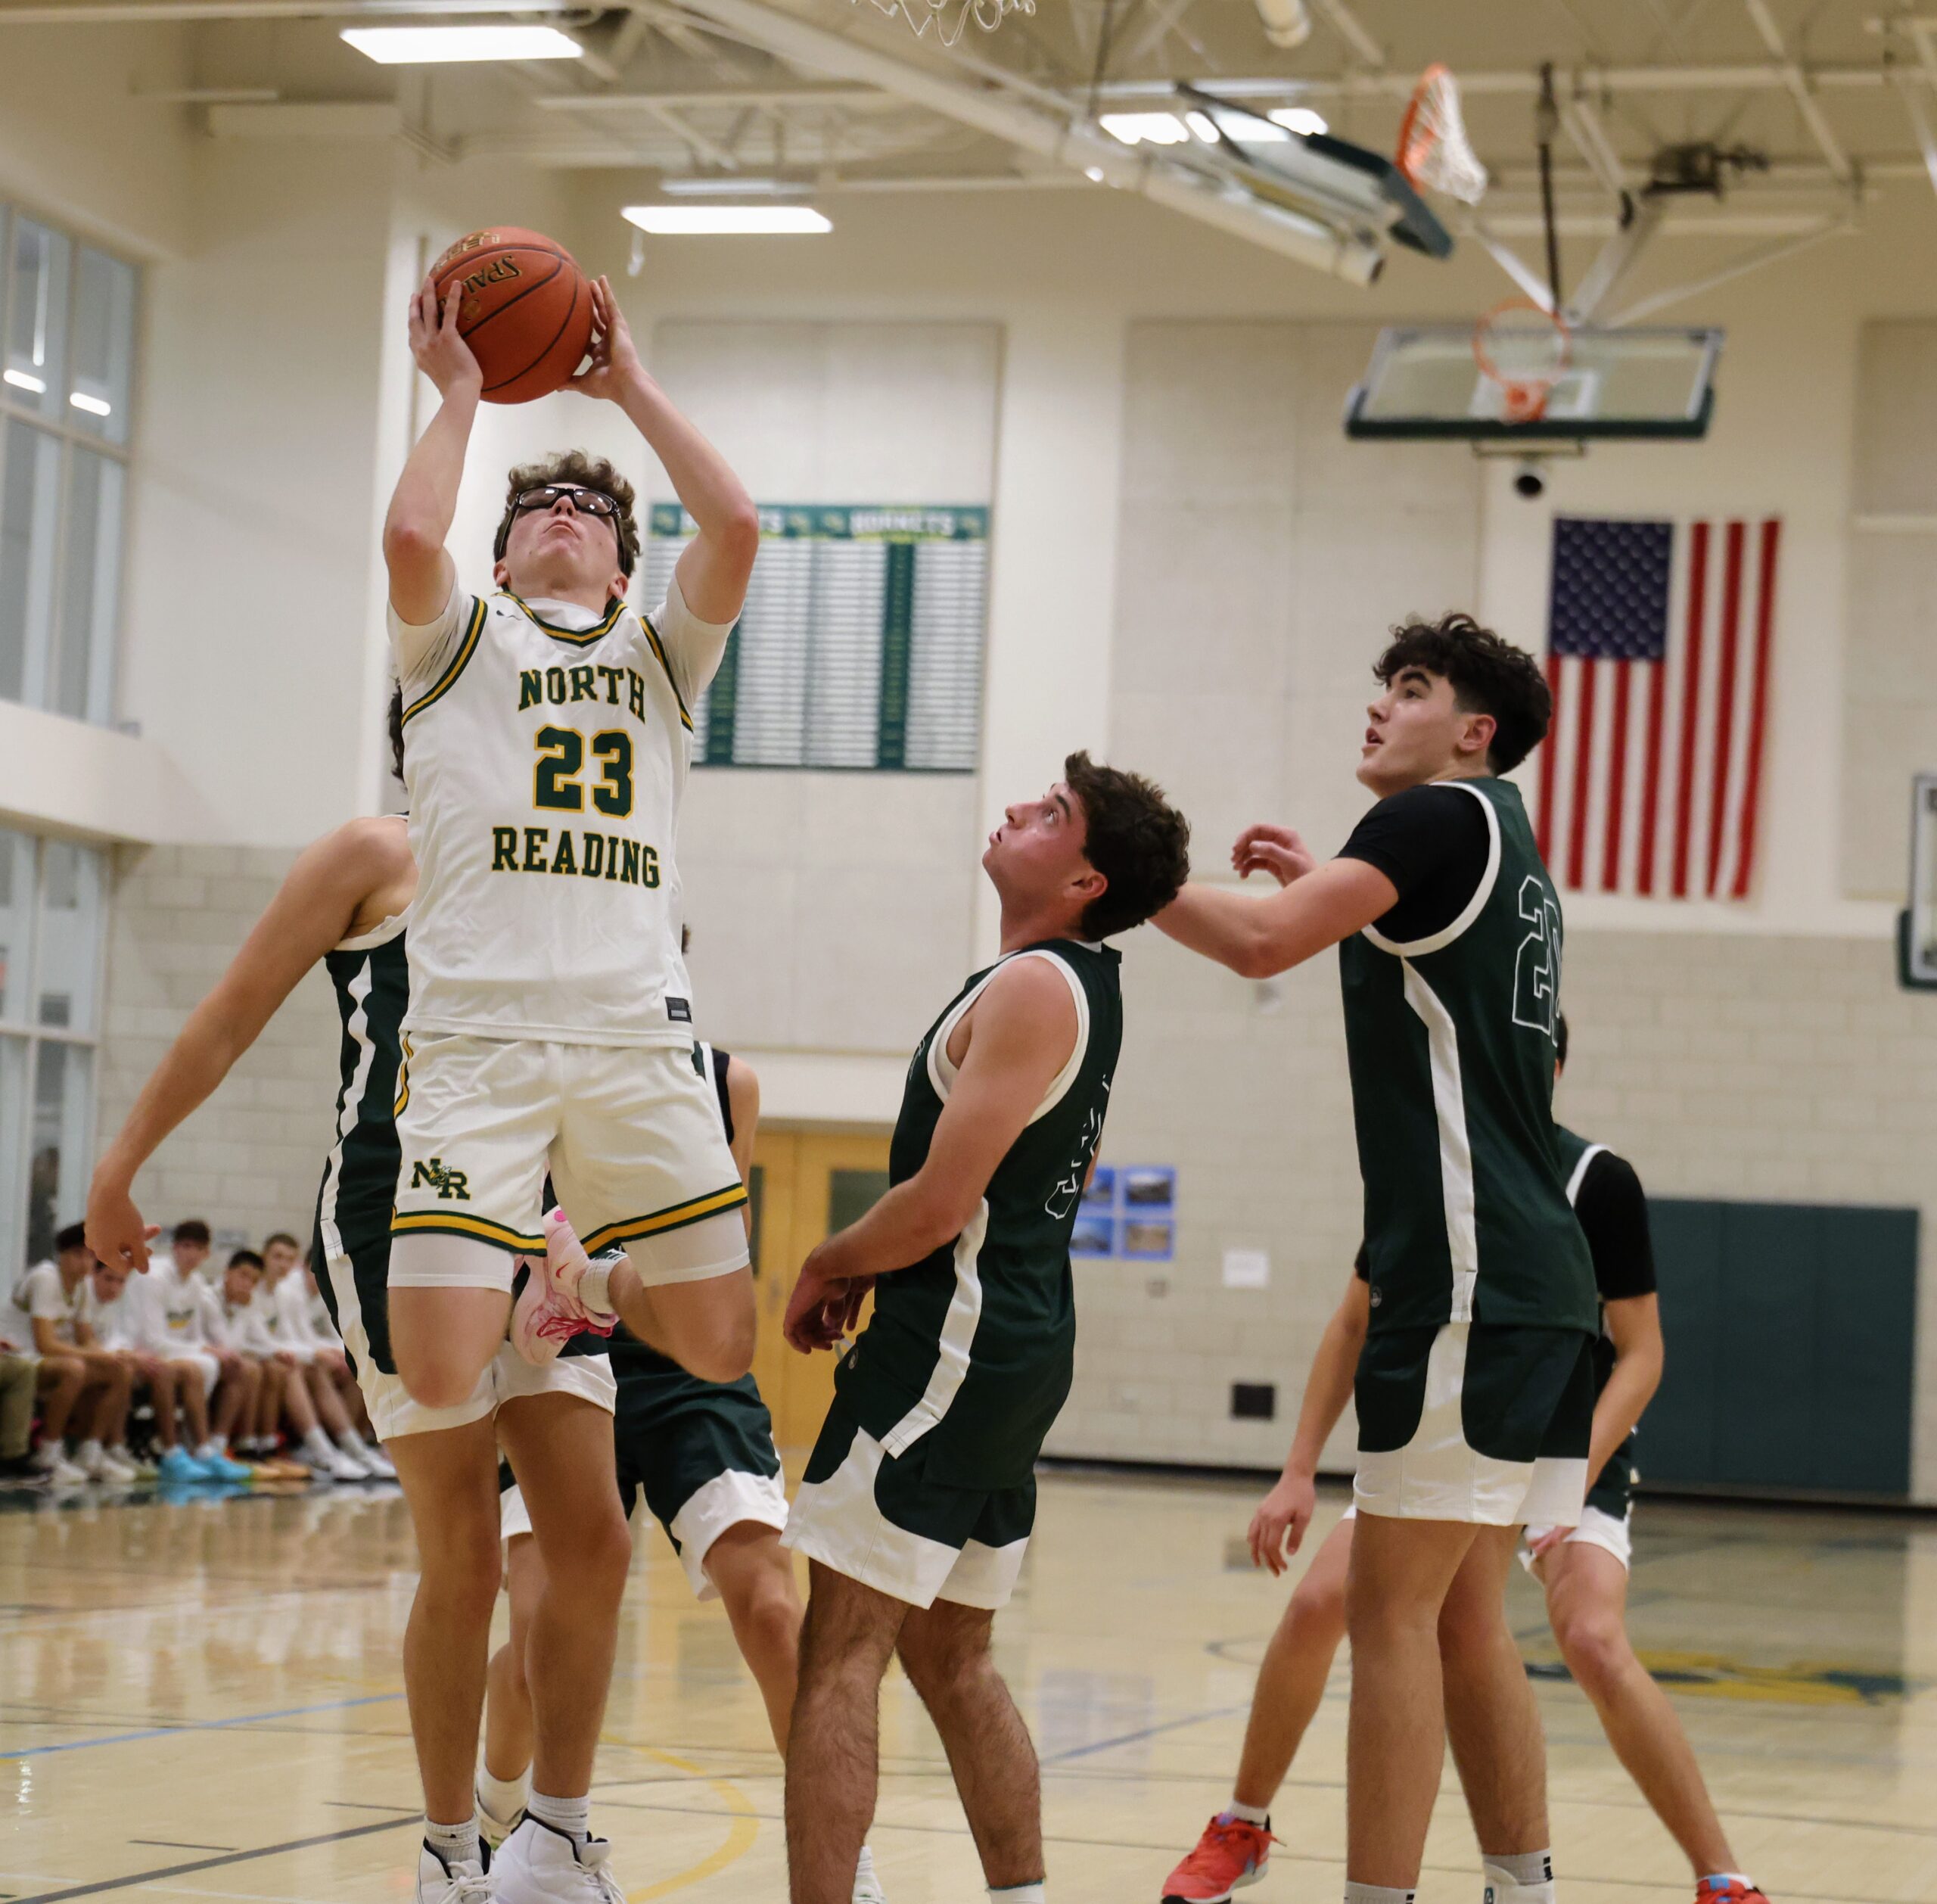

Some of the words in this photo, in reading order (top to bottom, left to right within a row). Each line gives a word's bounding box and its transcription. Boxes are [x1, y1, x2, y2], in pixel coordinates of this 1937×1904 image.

[518, 664, 646, 725] NORTH
[533, 723, 635, 821] 23
[491, 826, 661, 889] READING
